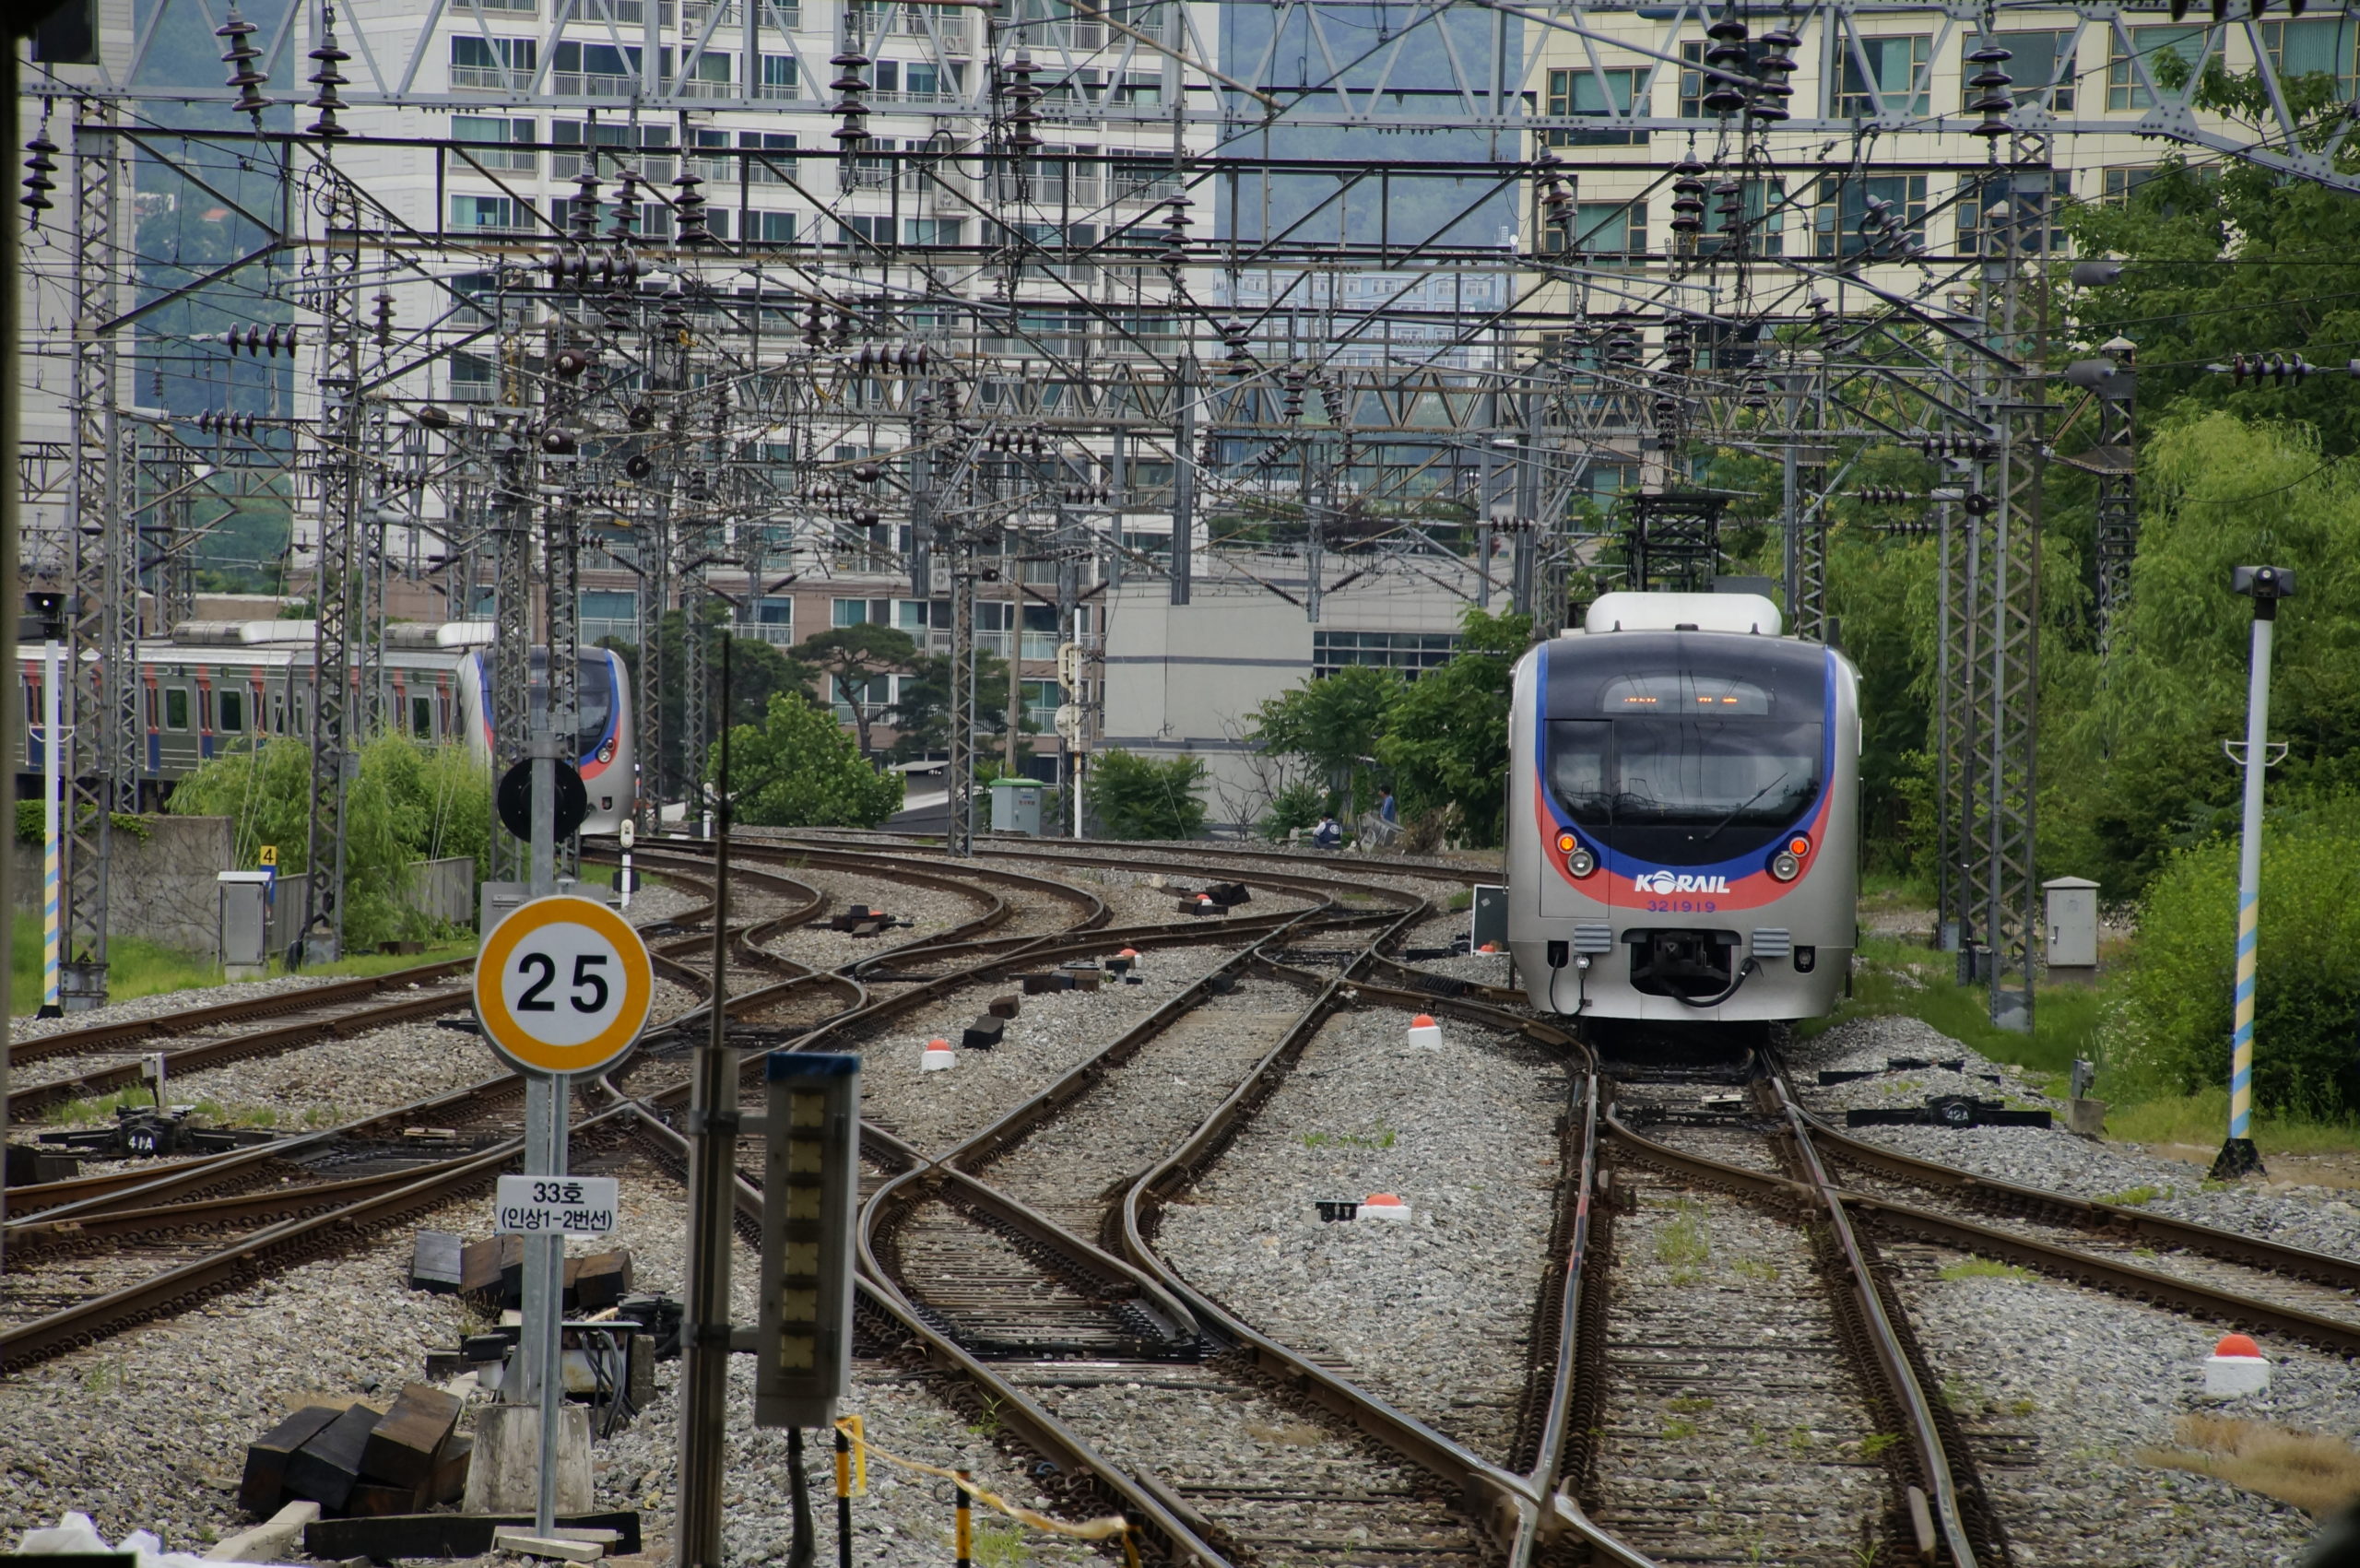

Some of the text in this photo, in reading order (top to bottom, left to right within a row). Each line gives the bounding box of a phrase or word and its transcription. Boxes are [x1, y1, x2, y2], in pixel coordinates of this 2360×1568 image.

[263, 847, 274, 864] 4
[1634, 869, 1730, 895] KORAIL
[1646, 900, 1717, 913] 321919
[516, 952, 608, 1014] 25
[1946, 1109, 1969, 1121] 42A
[128, 1135, 153, 1150] 41A
[533, 1182, 585, 1204] 33호
[502, 1207, 612, 1232] (인상1-2번선)
